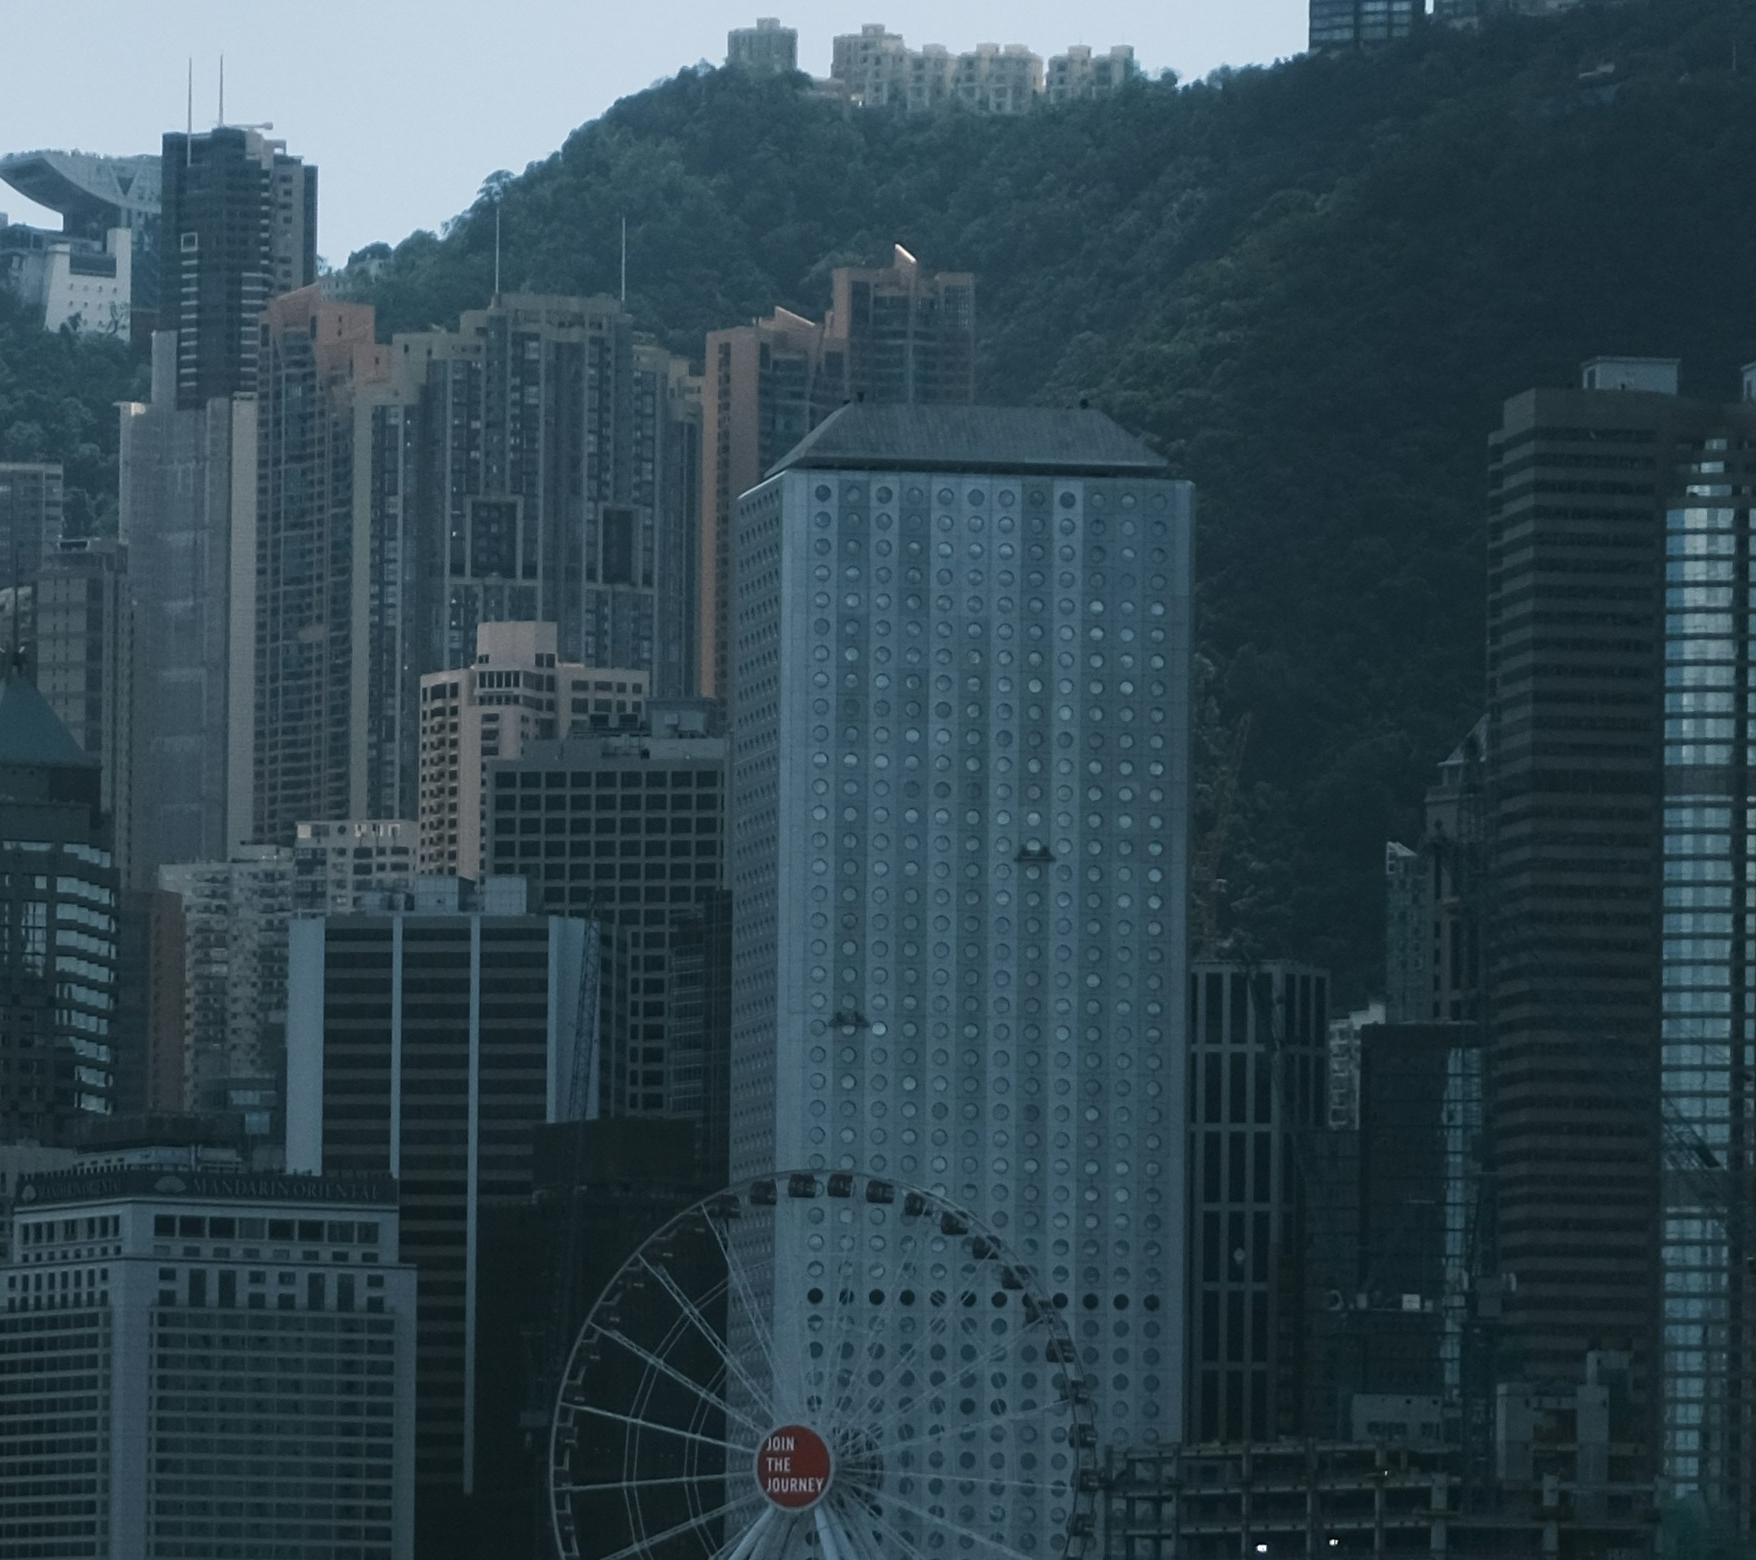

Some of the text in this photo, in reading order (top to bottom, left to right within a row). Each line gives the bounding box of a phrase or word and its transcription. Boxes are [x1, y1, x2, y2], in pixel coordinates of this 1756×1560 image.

[193, 1178, 289, 1197] MANDARIN
[766, 1436, 795, 1451] JOIN
[766, 1457, 791, 1472] THE
[766, 1476, 824, 1493] JOURNEY
